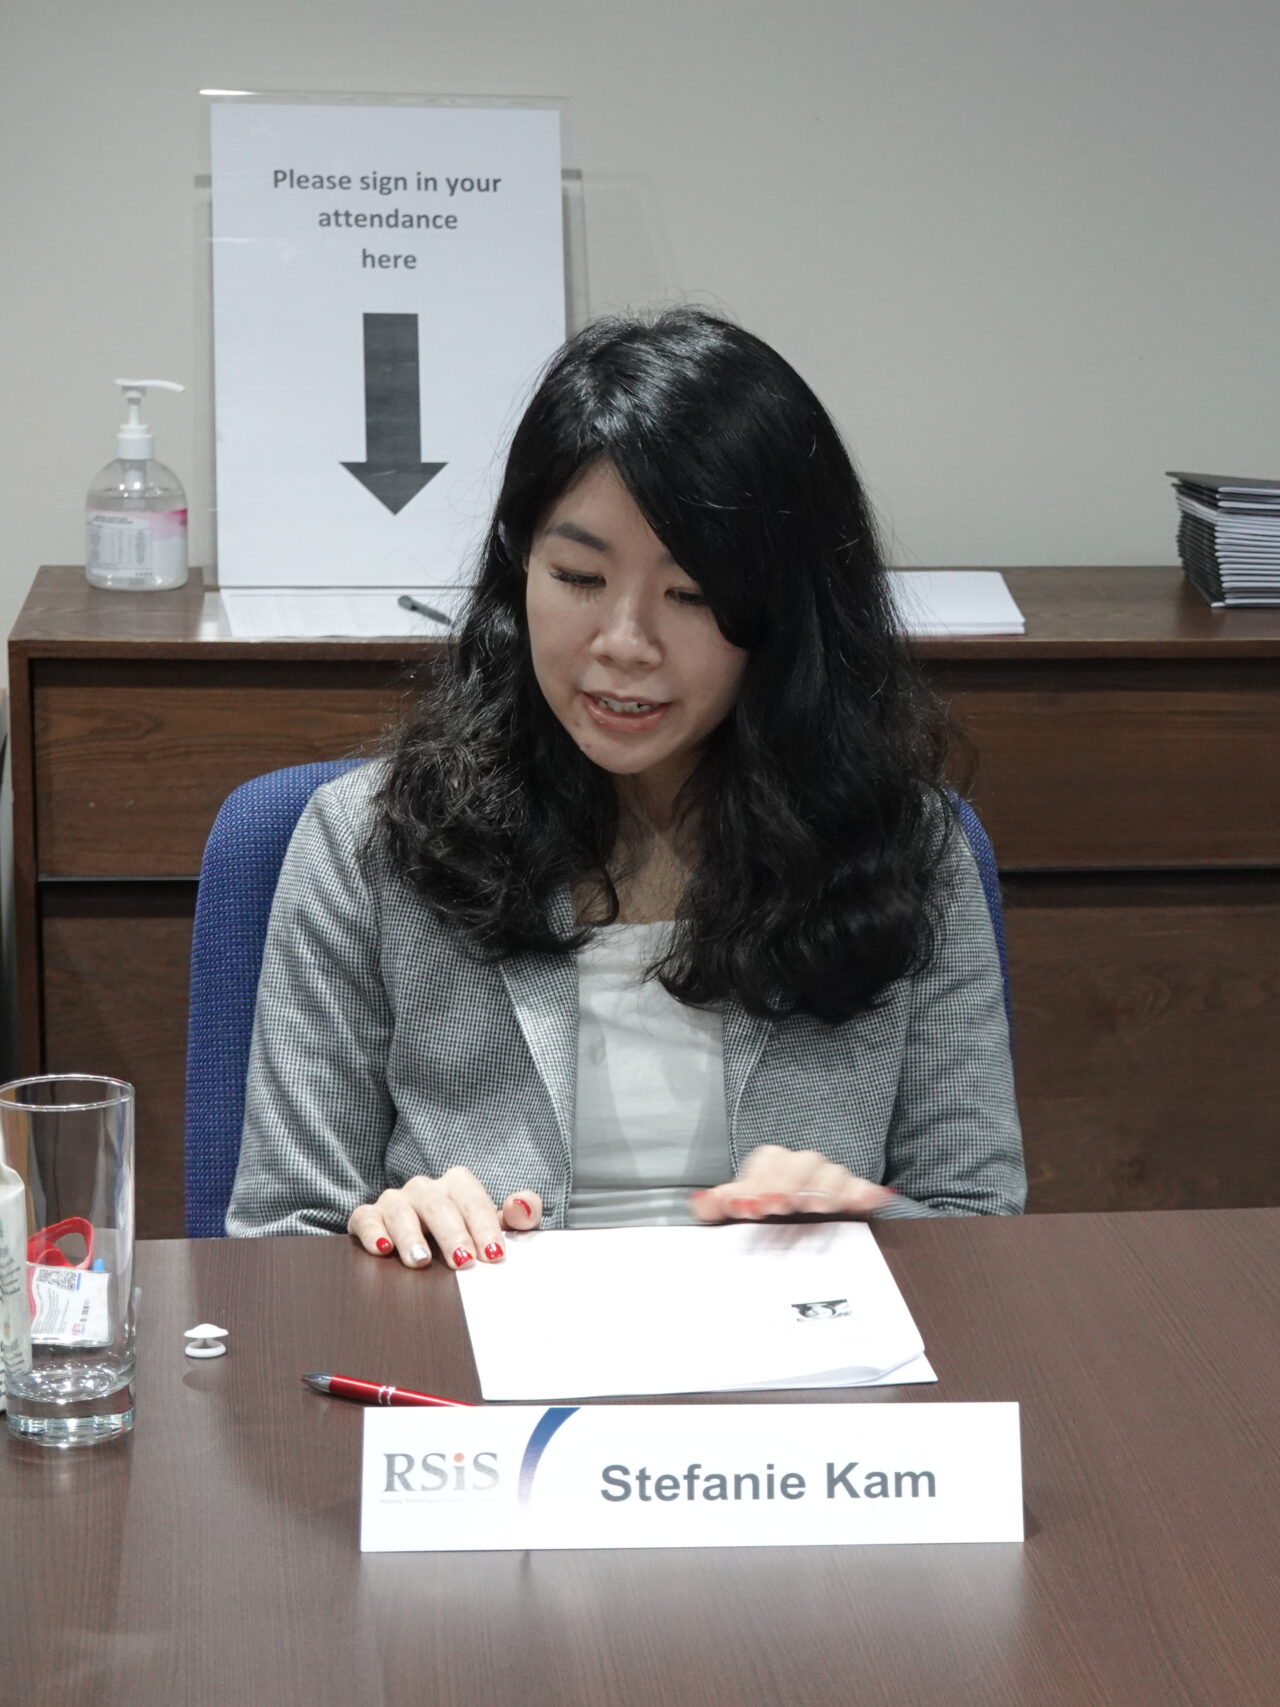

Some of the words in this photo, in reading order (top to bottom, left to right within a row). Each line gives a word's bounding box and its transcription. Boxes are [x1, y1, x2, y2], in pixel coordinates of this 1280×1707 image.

[273, 168, 352, 190] Please
[360, 171, 407, 195] sign
[416, 171, 438, 192] in
[446, 176, 502, 197] your
[318, 208, 458, 229] attendance
[361, 248, 417, 269] here
[600, 1463, 807, 1502] Stefanie
[825, 1461, 936, 1499] Kam
